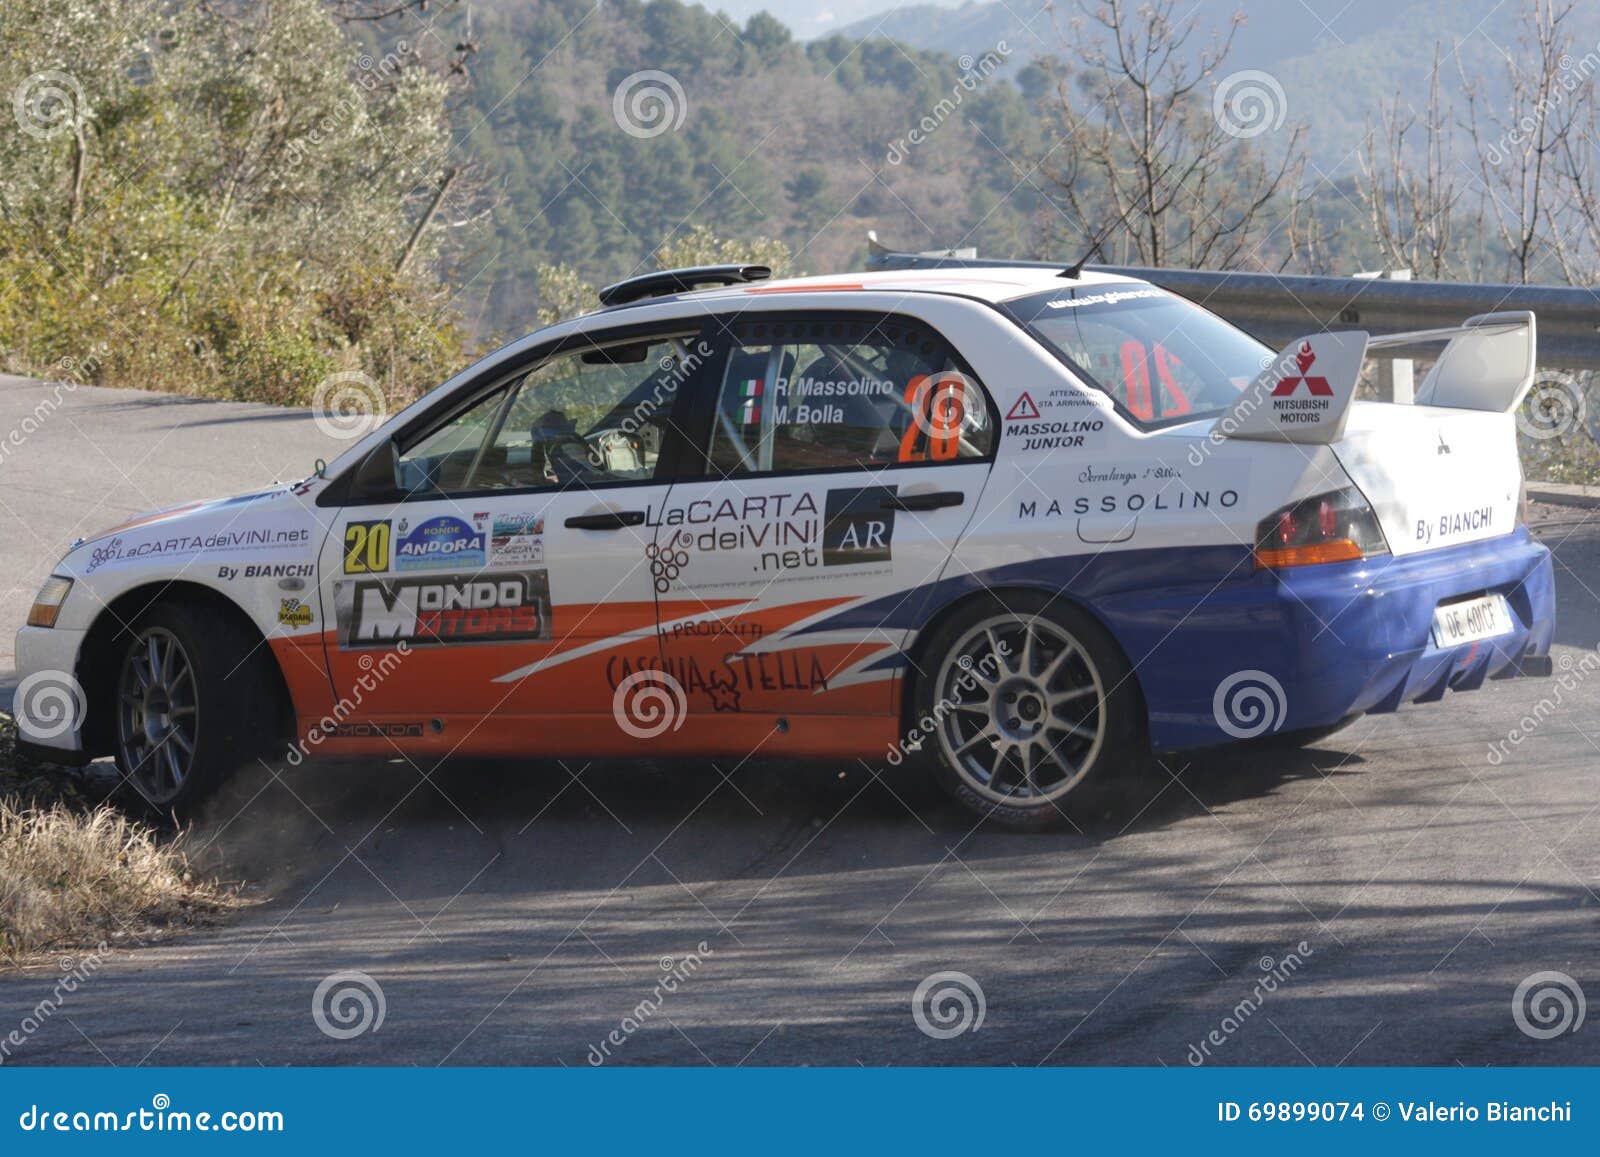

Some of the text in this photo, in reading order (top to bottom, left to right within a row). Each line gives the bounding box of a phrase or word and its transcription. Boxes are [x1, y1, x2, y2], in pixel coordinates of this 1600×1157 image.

[774, 377, 893, 396] R. Massolino
[774, 405, 843, 424] M. Bolla
[1273, 400, 1329, 410] MITSUBISHI
[1280, 412, 1320, 423] MOTORS
[1006, 420, 1104, 437] MASSOLINO
[1022, 436, 1084, 450] JUNIOR
[645, 492, 818, 527] LaCARTA
[1019, 490, 1239, 518] MASSOLINO
[1416, 506, 1493, 544] By BIANCHI
[698, 519, 818, 551] deiVINI
[837, 520, 888, 552] AR
[346, 522, 390, 573] 20
[400, 537, 480, 555] ANDORA
[753, 548, 818, 572] .net
[218, 564, 314, 579] By BIANCHI
